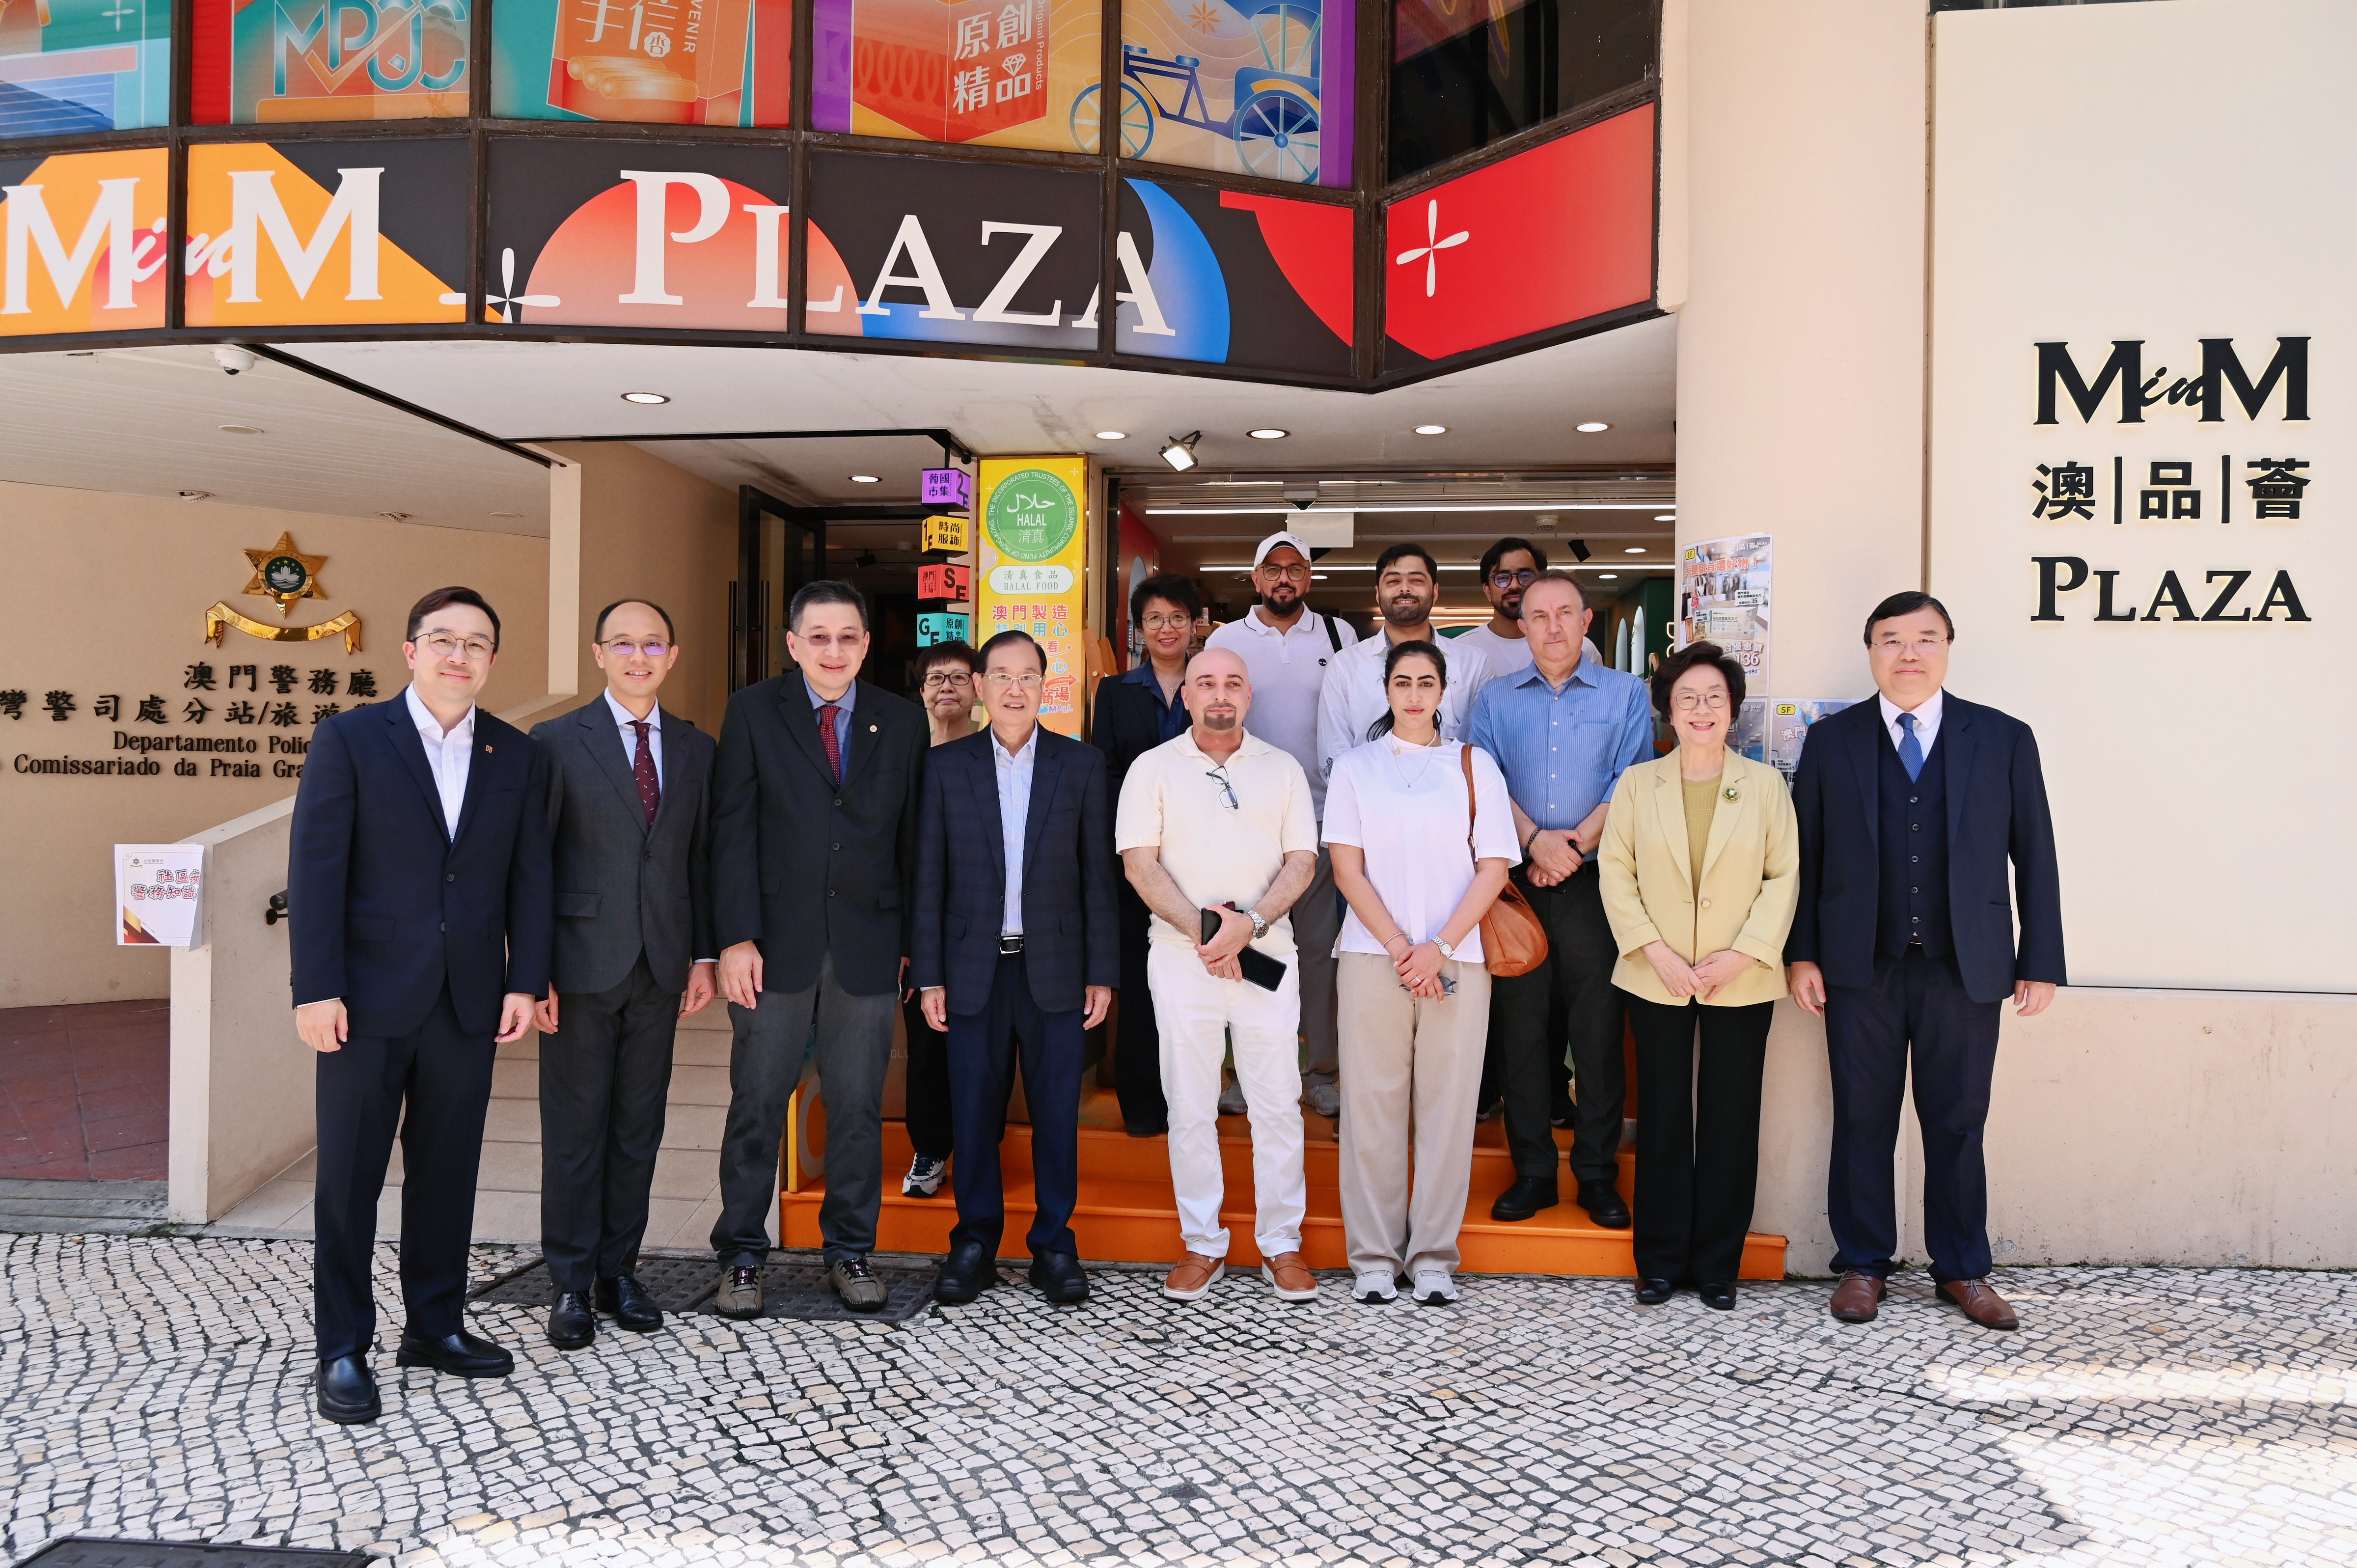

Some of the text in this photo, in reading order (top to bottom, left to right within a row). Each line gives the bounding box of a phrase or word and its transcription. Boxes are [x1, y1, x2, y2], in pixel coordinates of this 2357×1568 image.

[954, 0, 1032, 61] 原創
[1035, 41, 1045, 90] Products
[953, 65, 1032, 115] 精品
[619, 170, 1177, 336] PLAZA
[992, 472, 1030, 503] INCORPORATED
[1031, 471, 1061, 488] TRUSTEES
[928, 485, 950, 497] 市集
[1059, 485, 1068, 494] OF
[1007, 493, 1056, 513] حلال
[1064, 493, 1073, 506] THE
[939, 521, 960, 534] 時尚
[1017, 513, 1047, 526] HALAL
[1066, 506, 1075, 533] ISLAMIC
[938, 533, 959, 546] 服飾
[1018, 528, 1044, 544] 清真
[995, 537, 1012, 553] HONG
[1039, 533, 1069, 559] COMMUNITY
[923, 571, 934, 582] 澳門
[1004, 569, 1059, 580] 清真食品
[2030, 556, 2312, 622] PLAZA
[992, 604, 1069, 621] 澳門製造
[946, 618, 962, 630] 原創
[1735, 652, 1759, 666] 136
[184, 661, 378, 697] 澳門警務廳
[1049, 704, 1073, 714] MALL
[113, 731, 257, 754] Departamento
[14, 754, 161, 775] Comissariado
[174, 758, 197, 776] da
[210, 758, 261, 778] Praia
